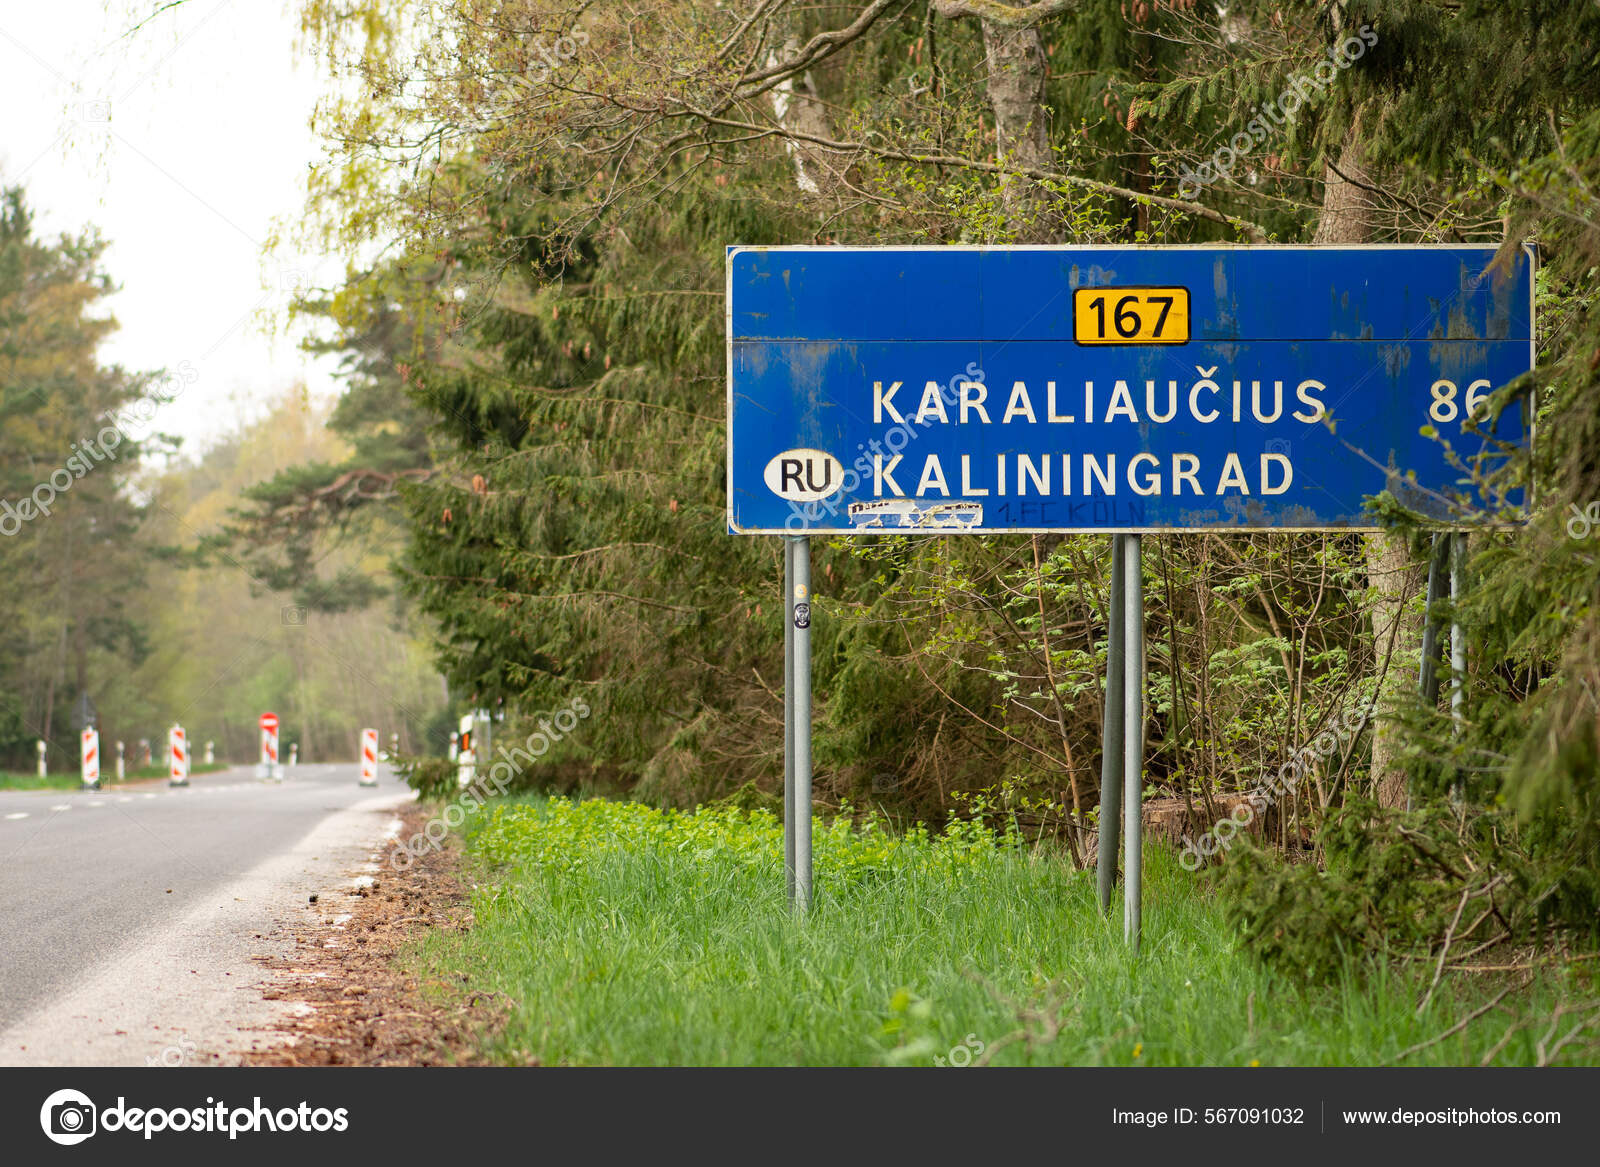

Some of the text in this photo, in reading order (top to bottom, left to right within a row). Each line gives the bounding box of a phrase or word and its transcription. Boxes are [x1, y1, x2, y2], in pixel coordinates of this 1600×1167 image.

[1089, 295, 1174, 339] 167
[872, 365, 1492, 424] KARALIAUČIUS 86
[781, 458, 832, 493] RU
[872, 452, 1294, 497] KALININGRAD
